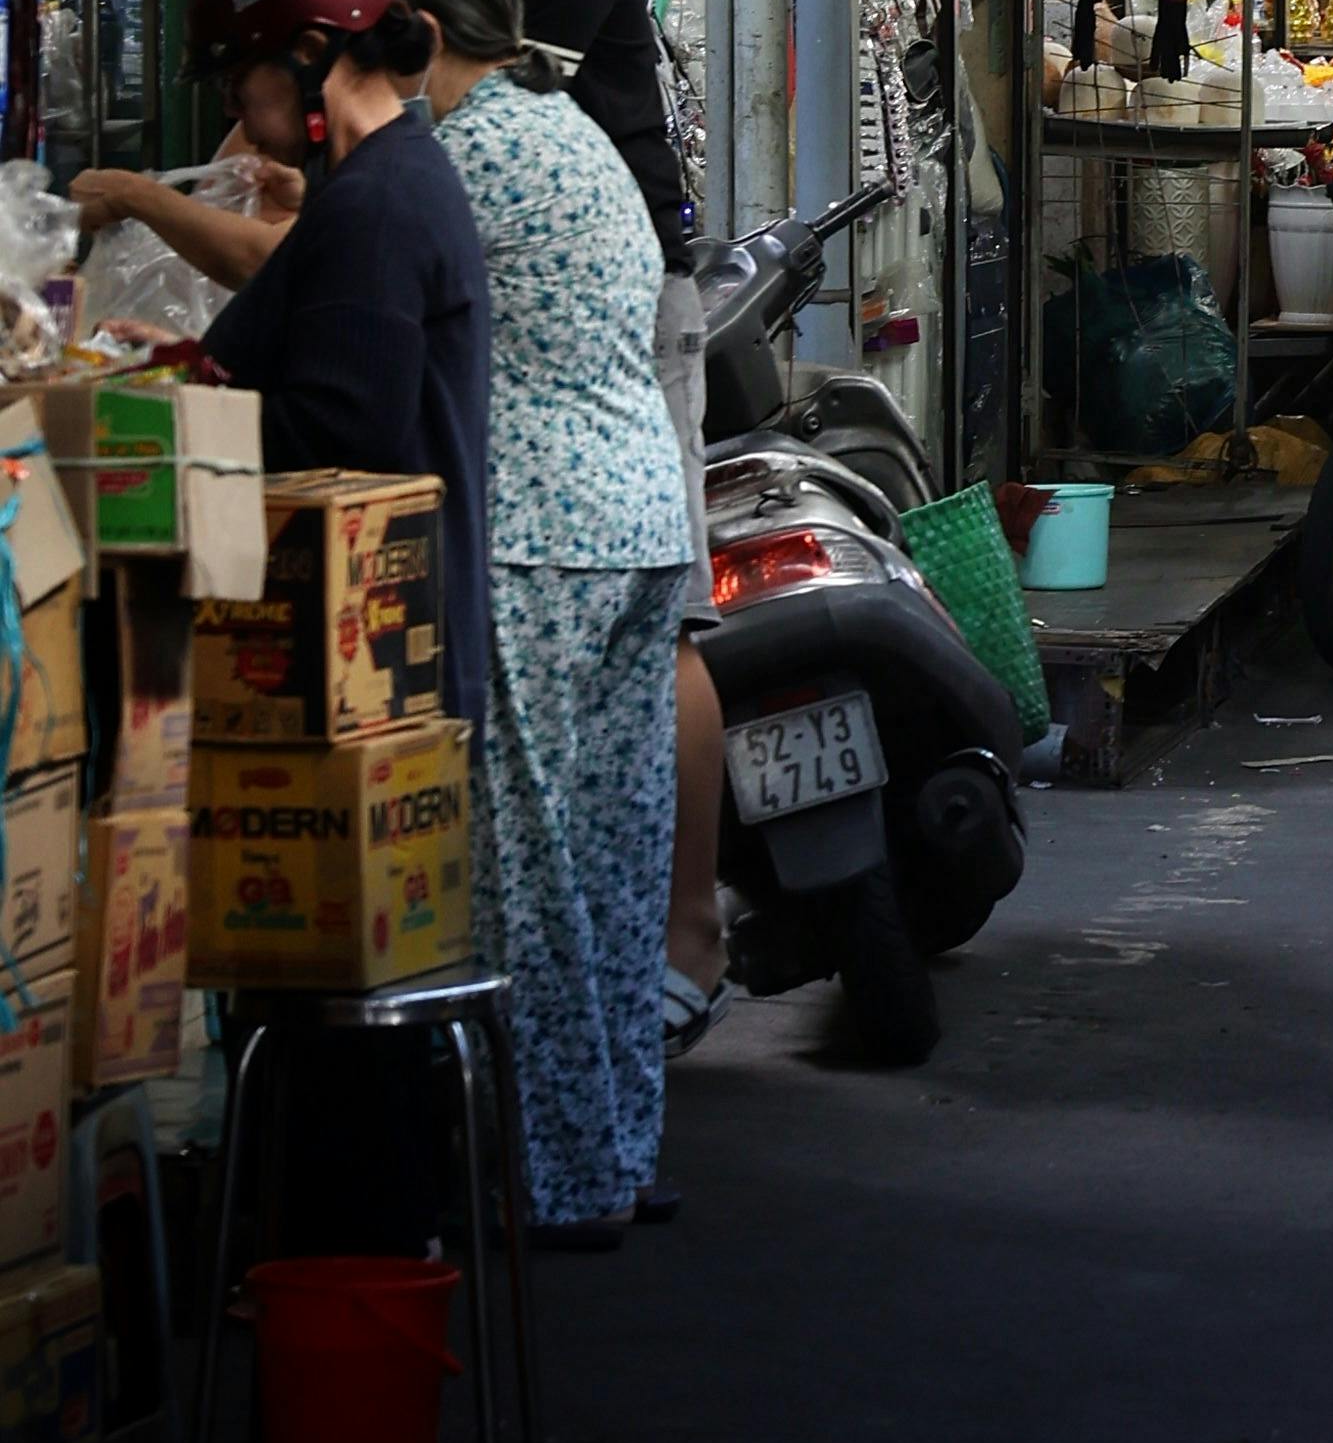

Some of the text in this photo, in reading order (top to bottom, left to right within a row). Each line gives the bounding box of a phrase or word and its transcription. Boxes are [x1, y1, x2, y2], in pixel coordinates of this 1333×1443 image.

[746, 704, 851, 768] 52-Y3
[760, 747, 862, 809] 4749
[193, 808, 349, 841] MODERN
[369, 783, 461, 844] MODERN
